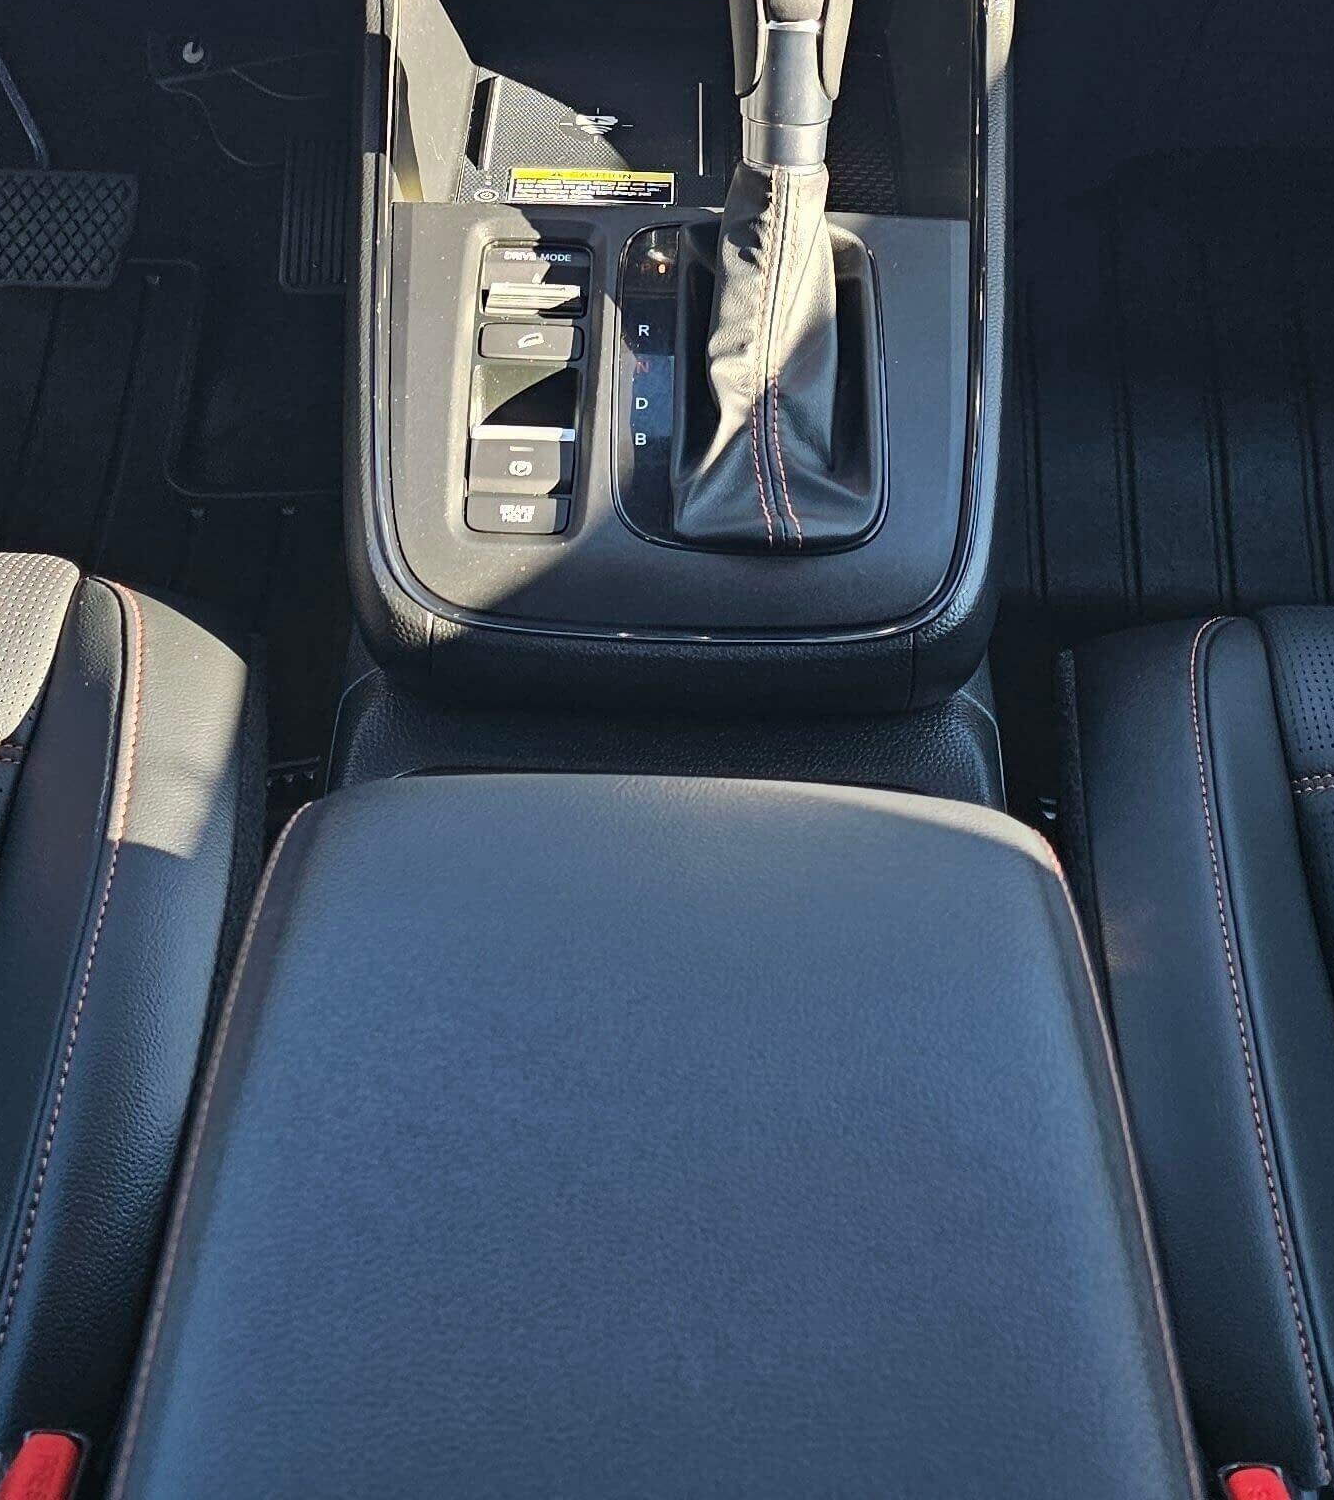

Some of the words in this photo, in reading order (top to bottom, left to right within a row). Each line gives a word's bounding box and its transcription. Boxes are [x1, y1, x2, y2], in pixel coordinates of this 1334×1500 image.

[540, 252, 572, 262] MODE
[638, 324, 650, 337] R
[636, 361, 649, 374] N
[635, 398, 649, 410] D
[635, 433, 647, 446] B
